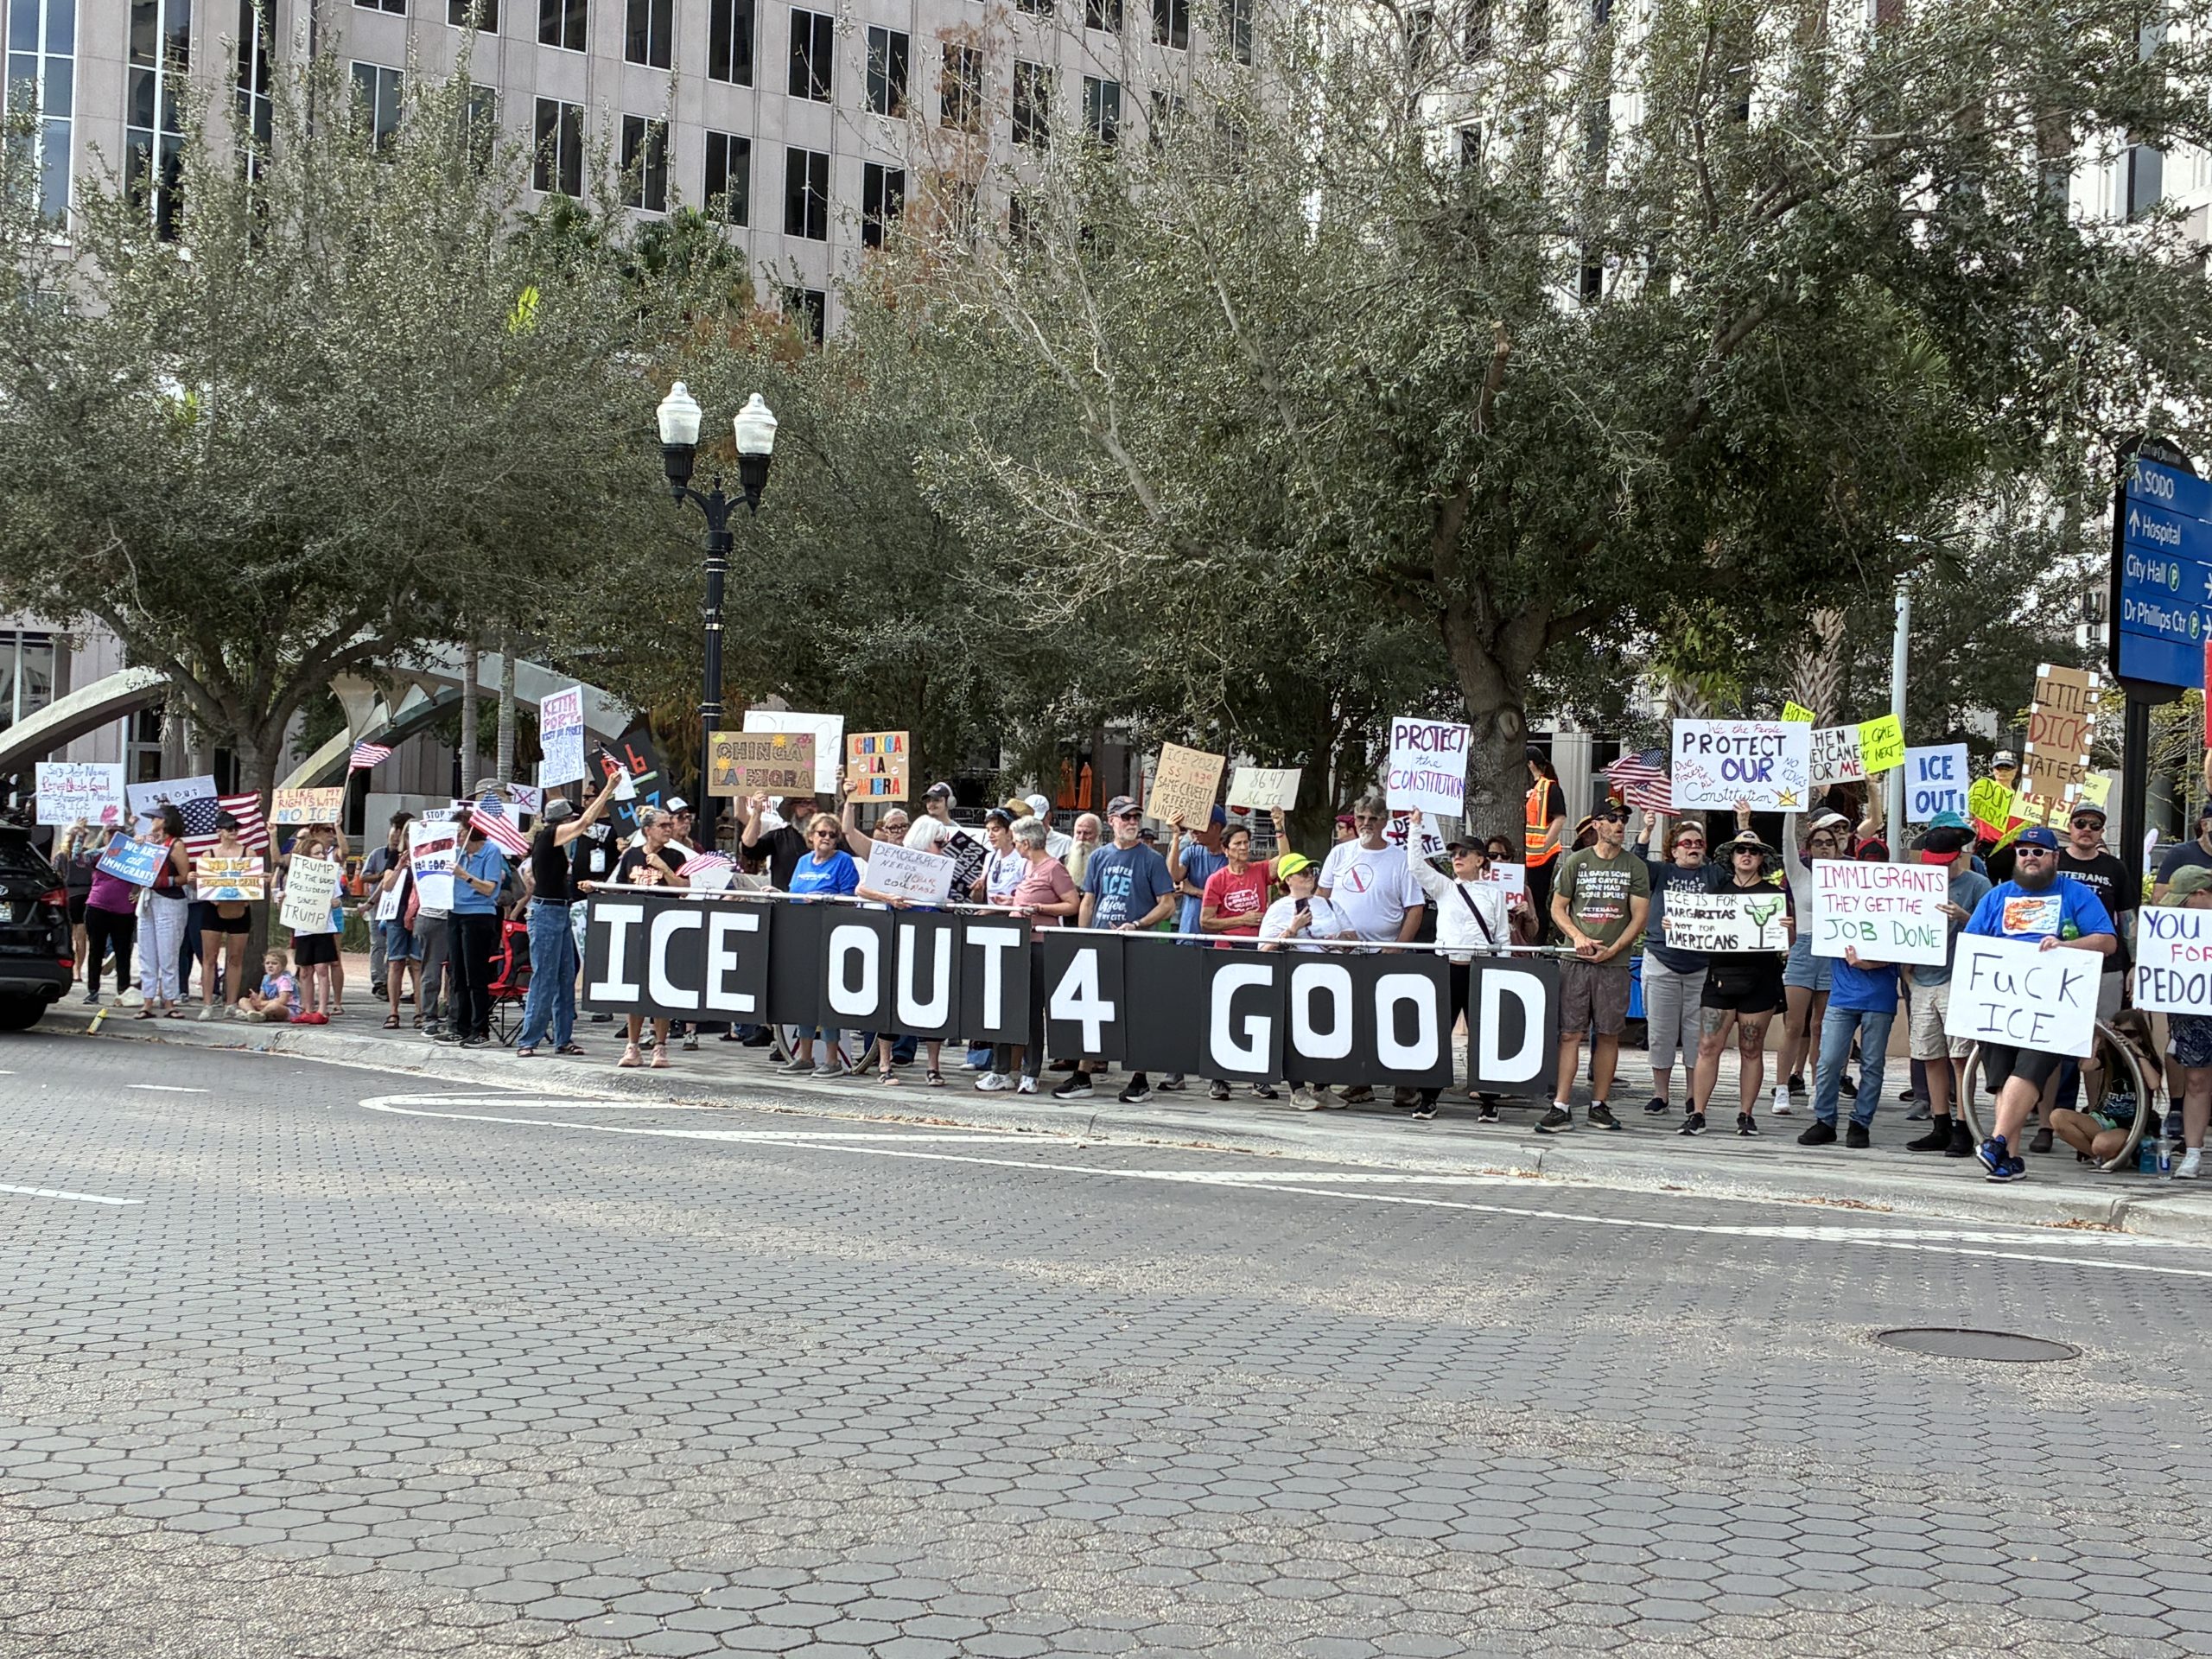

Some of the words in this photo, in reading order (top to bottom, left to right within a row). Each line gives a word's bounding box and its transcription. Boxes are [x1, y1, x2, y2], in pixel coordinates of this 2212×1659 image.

[2145, 471, 2174, 499] SODO
[2142, 516, 2181, 546] Hospital
[2126, 554, 2145, 584] City
[2147, 559, 2166, 585] Hall
[2124, 599, 2136, 620] Dr
[2173, 610, 2186, 632] Ctr
[2034, 680, 2099, 715] LITTLE
[1706, 721, 1725, 734] We
[1732, 722, 1748, 734] the
[1753, 723, 1782, 734] People
[2029, 713, 2094, 754] DICK
[854, 735, 902, 755] CHINGA
[1395, 724, 1470, 753] PROTECT
[1682, 732, 1787, 758] PROTECT
[716, 741, 804, 762] CHINGA
[1166, 747, 1190, 765] ICE
[1415, 754, 1443, 768] the
[1810, 747, 1824, 764] EY
[1826, 745, 1859, 762] CAME
[869, 756, 886, 774] LA
[1168, 766, 1182, 778] SS
[1721, 757, 1774, 783] OUR
[1783, 756, 1799, 768] NO
[1840, 760, 1861, 778] ME
[1919, 755, 1955, 782] ICE
[2025, 753, 2084, 783] TATER
[713, 768, 740, 786] LA
[747, 768, 812, 788] MIGRA
[857, 778, 901, 796] MIGRA
[1156, 776, 1180, 792] SAME
[1250, 770, 1266, 789] 86
[1270, 771, 1286, 790] 47
[1389, 769, 1466, 799] CONSTITUTION
[1782, 768, 1808, 788] KINGS
[175, 788, 199, 798] OUT
[277, 790, 283, 798] I
[287, 789, 314, 798] LIKE
[326, 787, 341, 798] MY
[1262, 792, 1284, 805] ICE
[1685, 782, 1772, 804] Constitution
[278, 798, 315, 808] RIGHTS
[316, 798, 341, 808] WITH
[1915, 789, 1966, 817] OUT!
[2023, 792, 2077, 814] REIST
[277, 809, 302, 822] NO
[309, 808, 338, 822] ICE
[426, 810, 445, 819] STOP
[124, 841, 138, 854] WE
[140, 844, 156, 858] ARE
[873, 845, 948, 871] DEMOCRACY
[102, 856, 156, 881] IMMIGRANTS
[125, 856, 146, 866] all
[293, 856, 334, 874] TRUMP
[880, 860, 917, 872] NEEDS
[904, 872, 936, 887] YOUR
[1481, 868, 1500, 881] CE
[1816, 865, 1945, 893] IMMIGRANTS
[2056, 870, 2113, 887] TERANS.
[884, 879, 936, 894] COURAGE
[1103, 874, 1133, 896] ICE
[1665, 892, 1690, 904] ICE
[1696, 894, 1708, 906] IS
[1716, 895, 1738, 907] FOR
[1822, 894, 1860, 913] THEY
[1865, 896, 1894, 912] GET
[1897, 897, 1923, 915] THE
[284, 904, 326, 925] TRUMP
[1665, 906, 1737, 920] MARGARITAS
[1699, 924, 1716, 932] FOR
[1824, 918, 1878, 941] JOB
[1890, 920, 1942, 948] DONE
[2143, 910, 2200, 939] YOU
[1668, 931, 1738, 950] AMERICANS
[2171, 944, 2212, 964] FOR
[589, 903, 760, 1013] ICE
[827, 924, 1020, 1030] OUT
[1049, 948, 1116, 1053] 4
[1210, 963, 1547, 1083] GOOD
[2138, 965, 2212, 1005] PEDO
[1976, 1002, 2056, 1043] ICE
